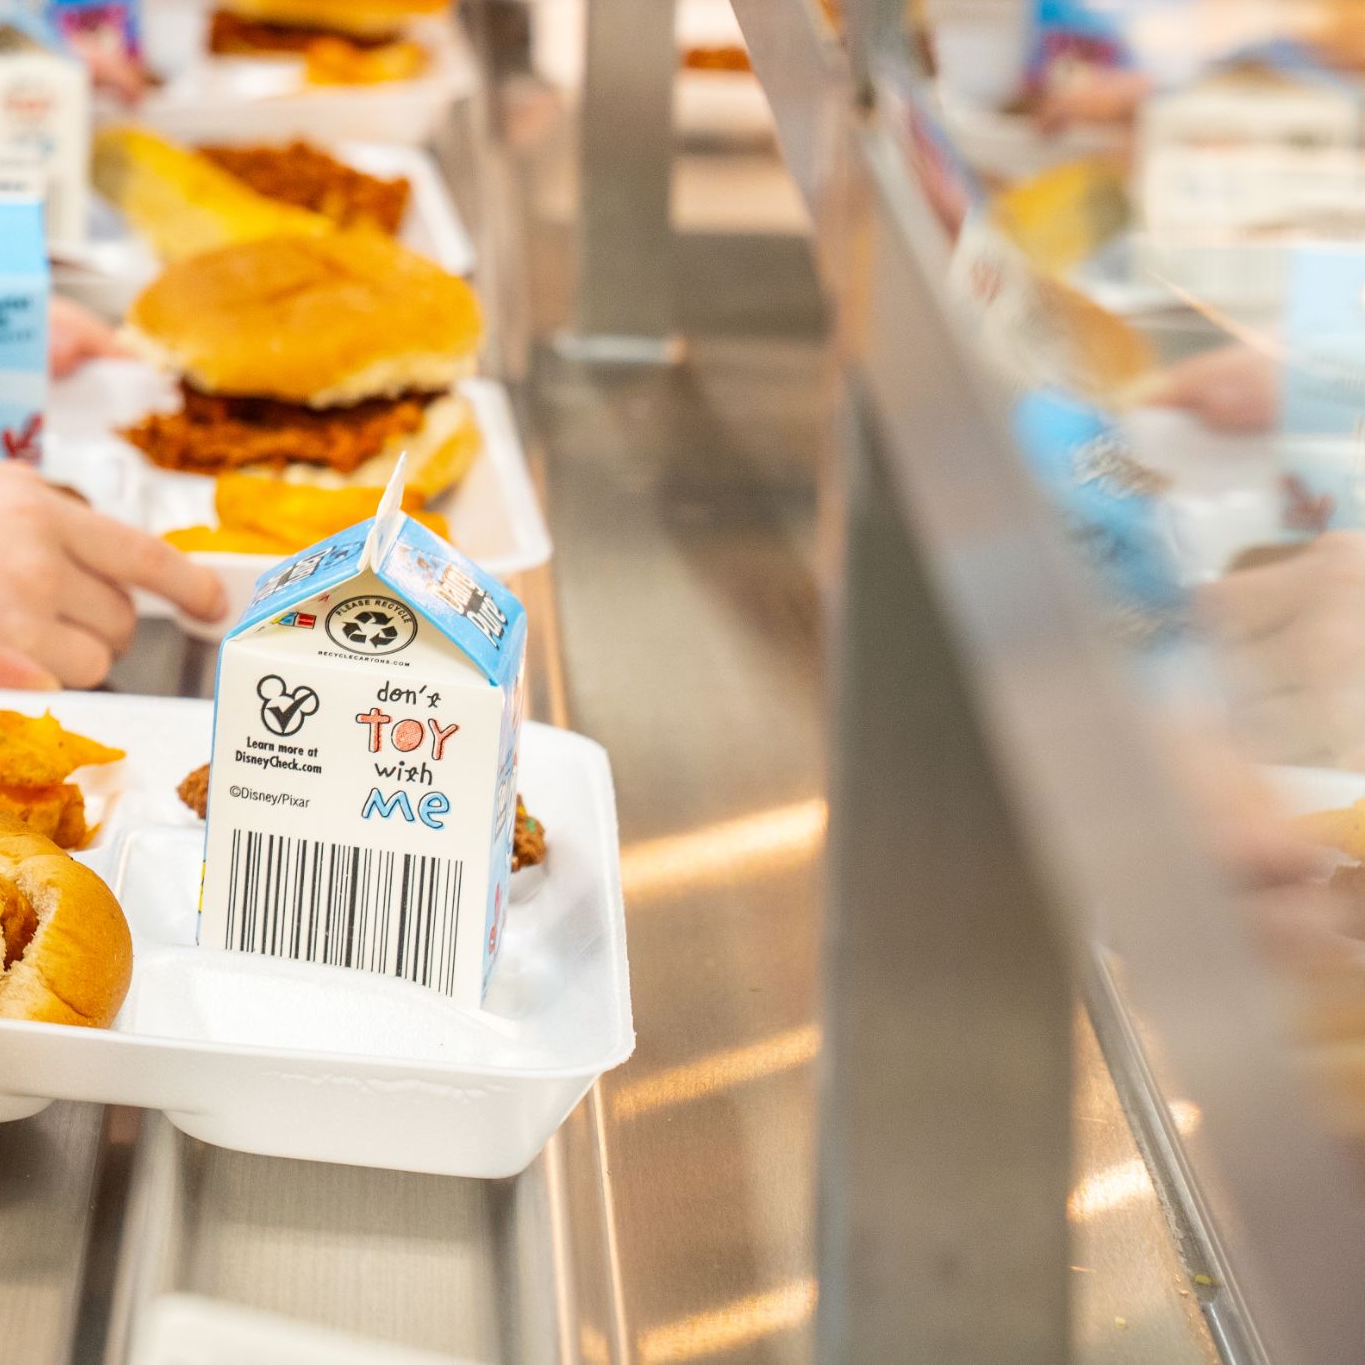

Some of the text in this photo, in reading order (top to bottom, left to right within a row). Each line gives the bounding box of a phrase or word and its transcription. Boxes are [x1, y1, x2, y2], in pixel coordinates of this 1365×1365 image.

[335, 599, 413, 624] PLEASE RECYCLE
[318, 650, 410, 667] RECYCLECARTONS.COM
[376, 680, 441, 708] don't
[246, 736, 319, 758] Learn more at
[235, 750, 322, 774] DisneyCheck.com
[374, 760, 433, 786] with
[229, 785, 311, 809] ©Disney/Pixar
